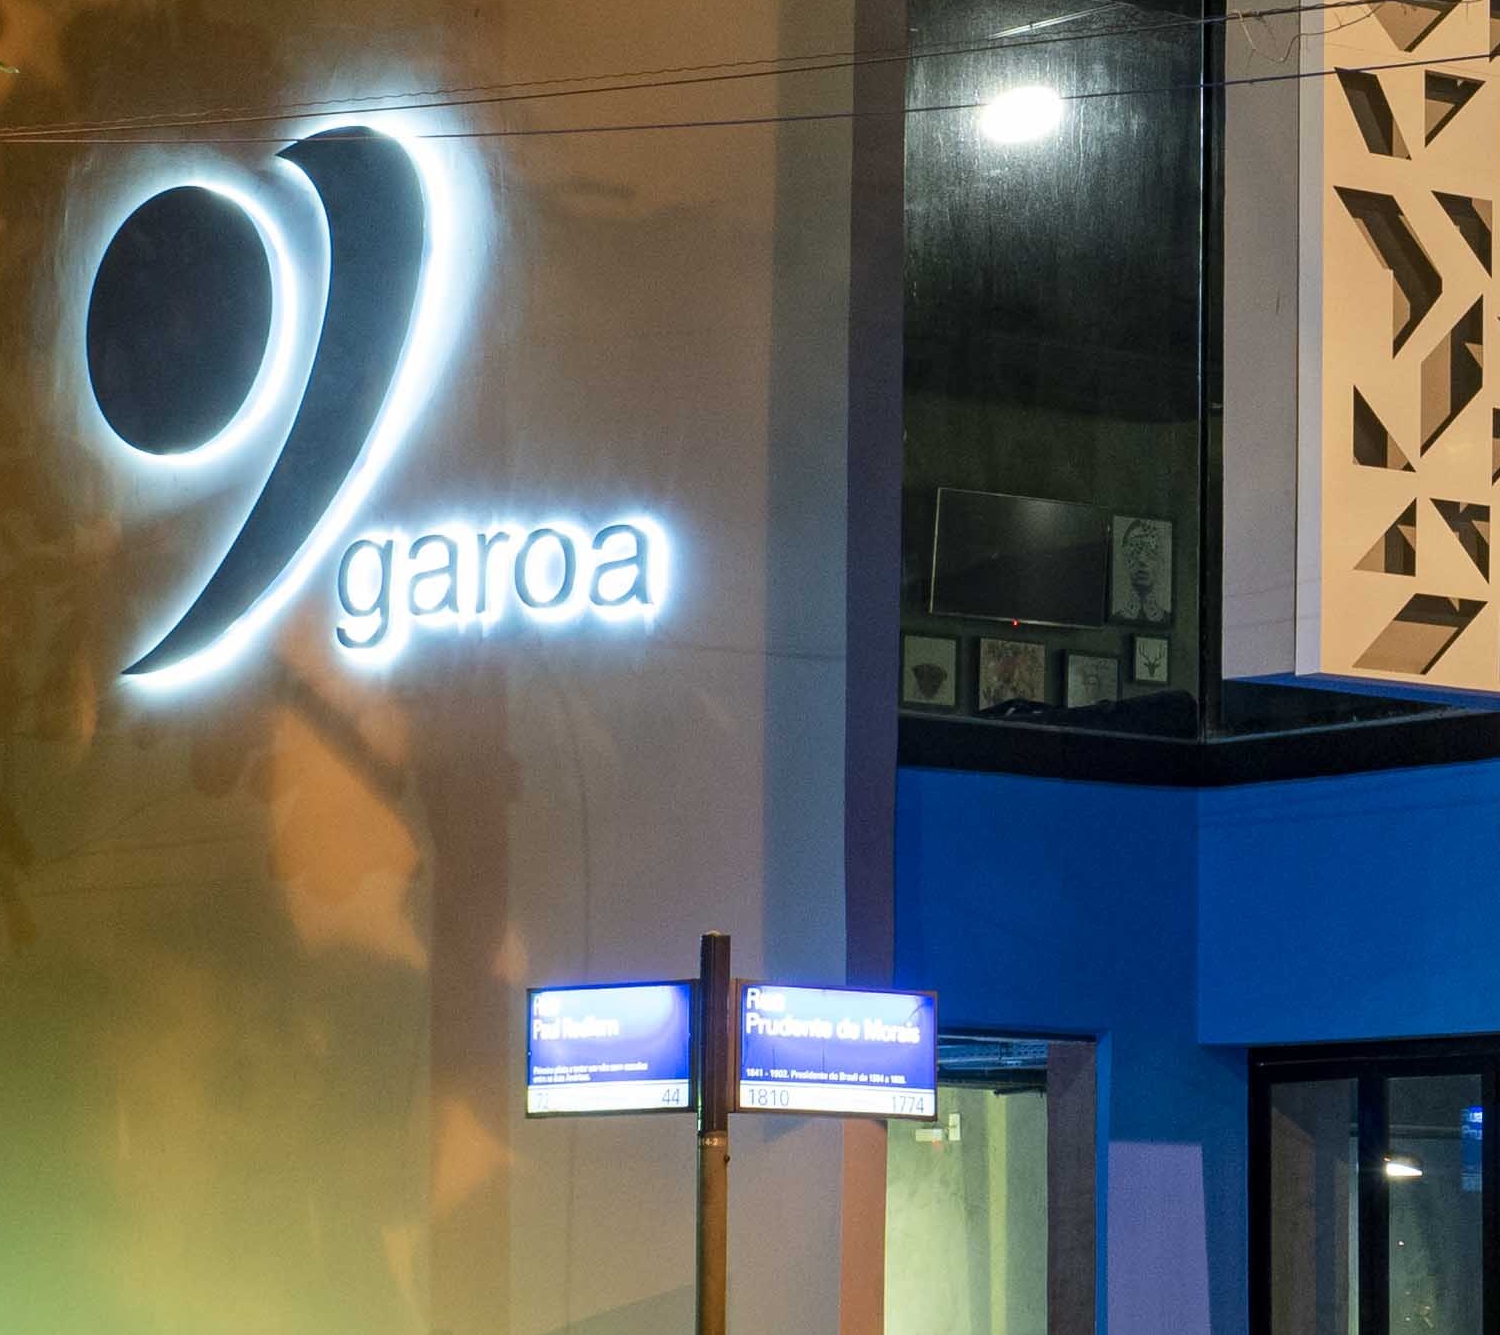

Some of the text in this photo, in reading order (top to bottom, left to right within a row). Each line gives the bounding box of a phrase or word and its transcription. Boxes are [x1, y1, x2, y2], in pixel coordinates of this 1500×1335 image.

[336, 523, 655, 650] garoa
[746, 987, 786, 1011] Rua
[745, 1012, 833, 1039] Prudente
[863, 1016, 921, 1044] Morais
[661, 1088, 680, 1105] 44
[748, 1088, 790, 1107] 1810
[891, 1096, 925, 1114] 1774
